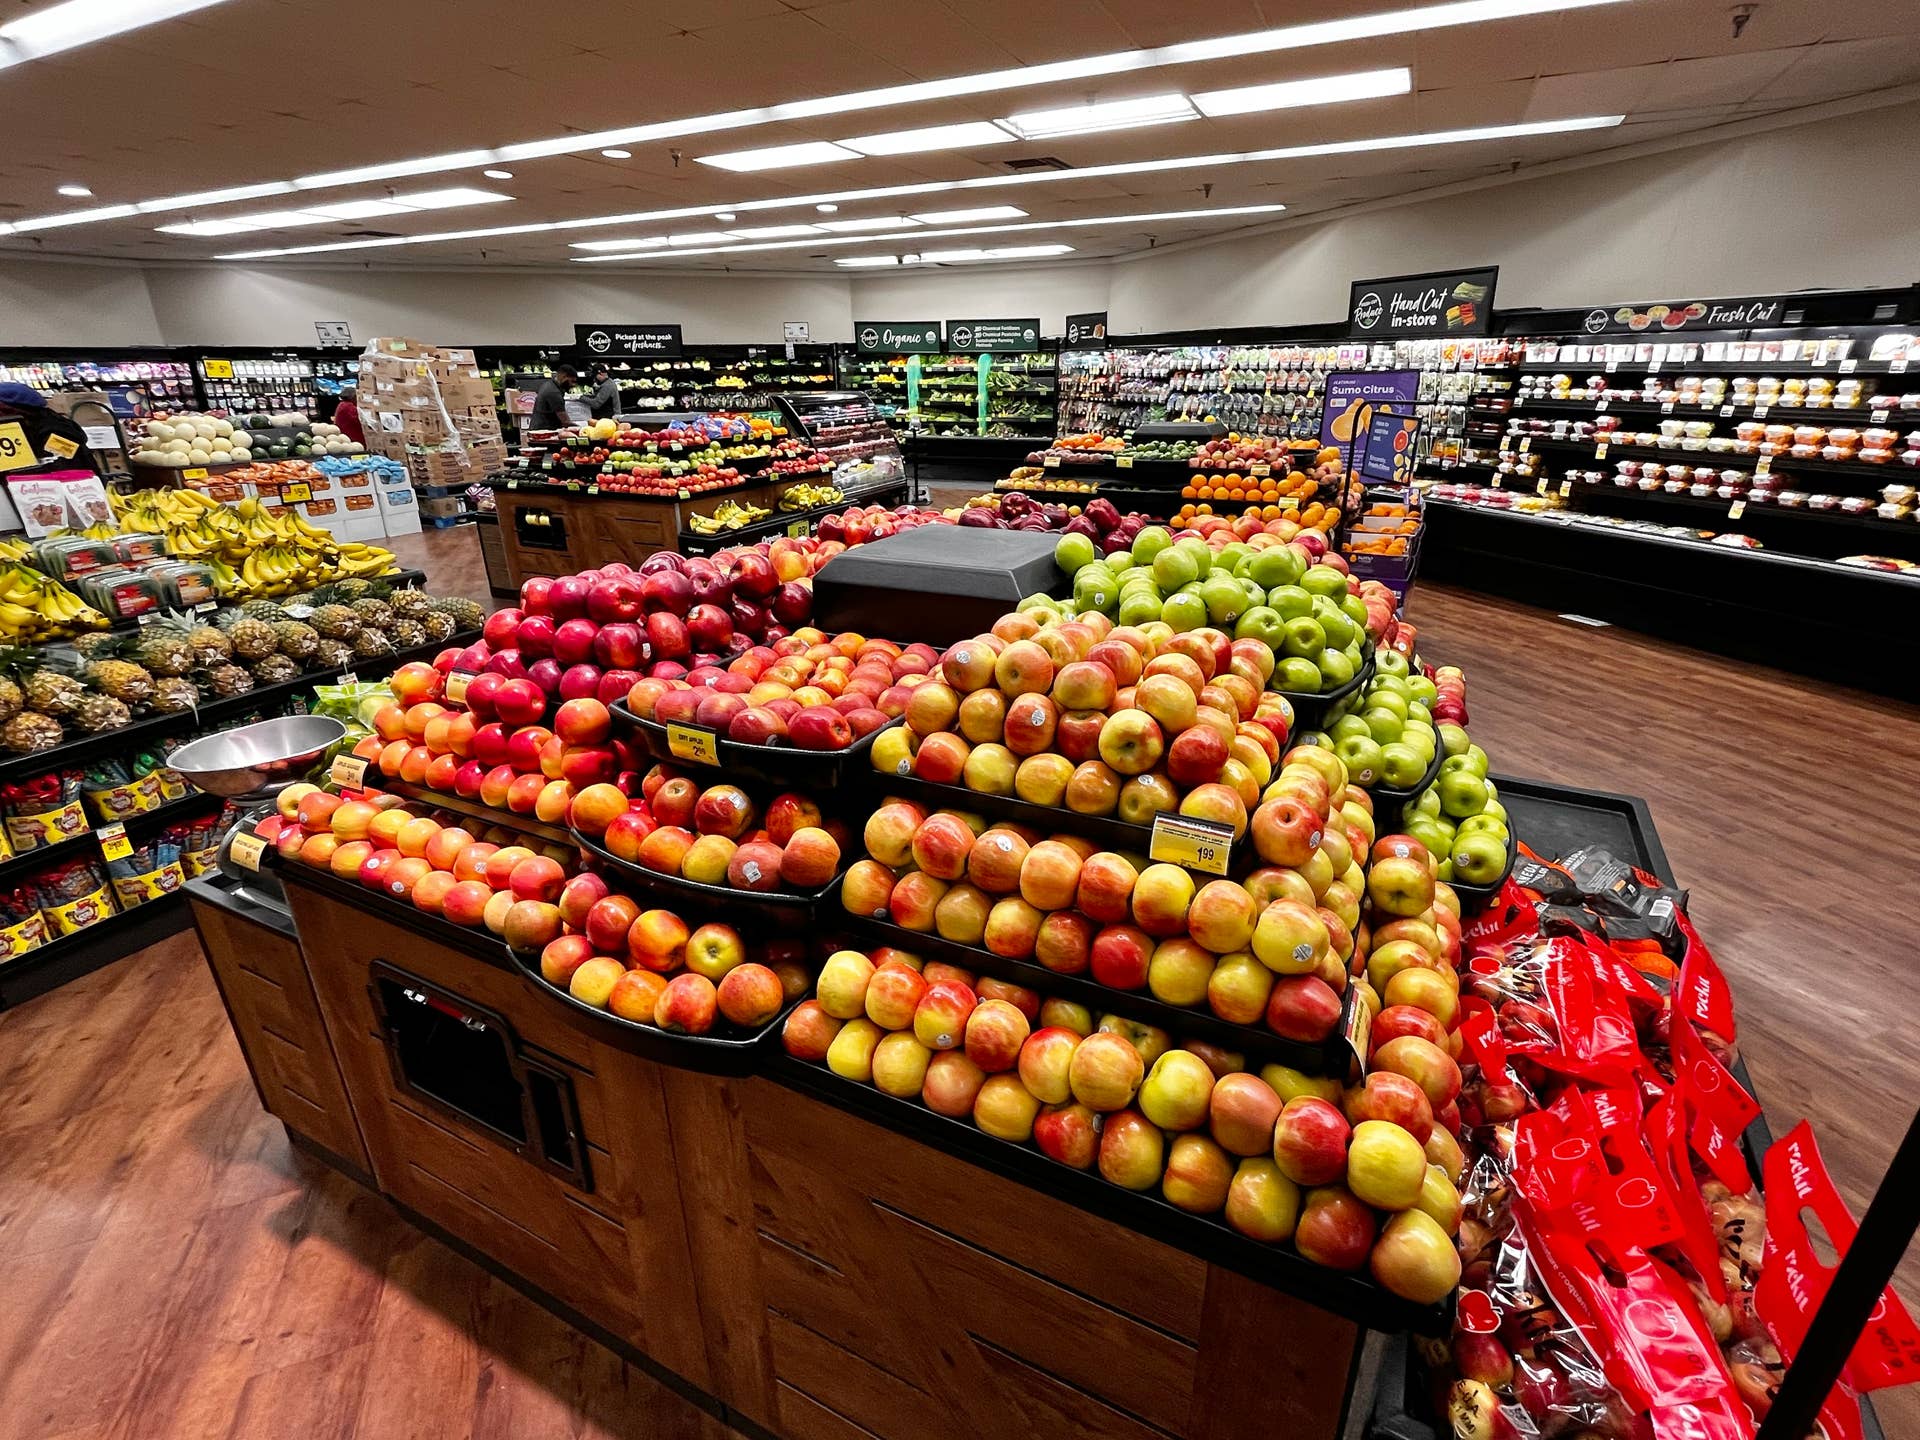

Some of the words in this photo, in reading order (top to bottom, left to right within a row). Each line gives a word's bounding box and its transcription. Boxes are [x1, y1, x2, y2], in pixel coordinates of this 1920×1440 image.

[1389, 291, 1424, 313] Hand
[1422, 287, 1448, 312] Cut
[1354, 305, 1383, 322] Produce
[1391, 314, 1438, 328] in-store
[1707, 305, 1744, 325] Fresh
[1746, 302, 1777, 323] Cut
[645, 333, 657, 341] the
[657, 333, 673, 342] peak
[882, 328, 921, 349] Organic
[1331, 386, 1361, 395] Sumo
[1362, 385, 1395, 394] Citrus
[1788, 1141, 1814, 1200] rockit
[1784, 1249, 1810, 1313] rockit
